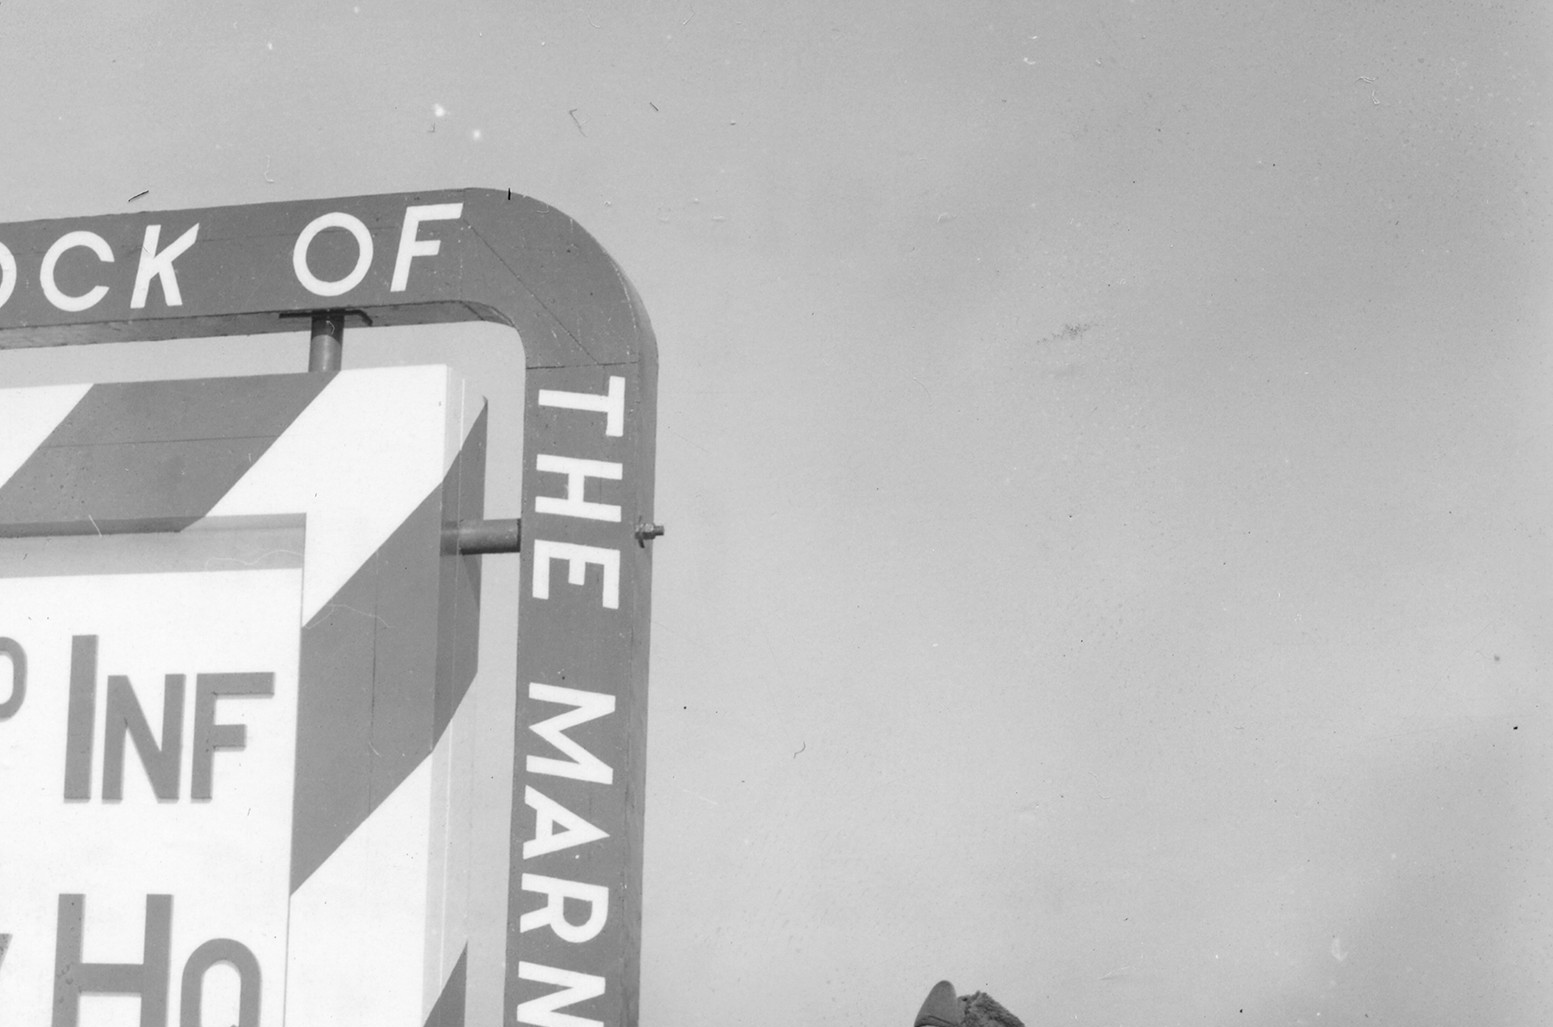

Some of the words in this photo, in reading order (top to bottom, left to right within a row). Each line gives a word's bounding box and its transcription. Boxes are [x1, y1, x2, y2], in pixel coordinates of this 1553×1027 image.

[293, 203, 464, 297] OF
[532, 376, 626, 610] THE
[63, 634, 276, 804] INF
